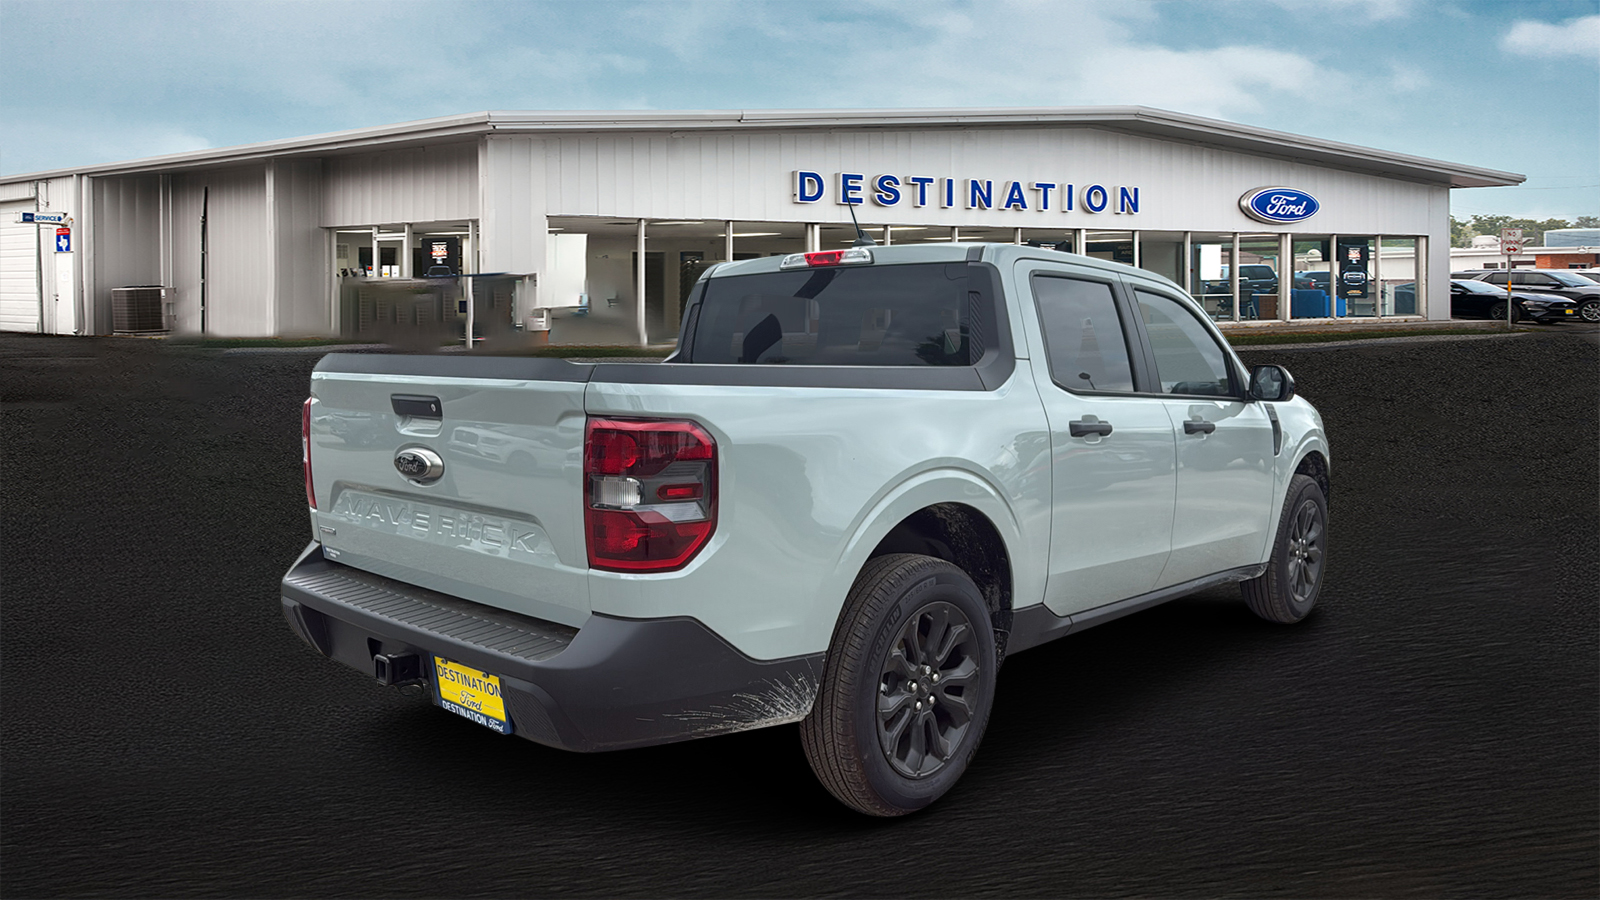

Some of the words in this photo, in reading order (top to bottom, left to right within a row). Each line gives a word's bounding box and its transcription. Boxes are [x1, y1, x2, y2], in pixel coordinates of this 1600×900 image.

[793, 170, 1141, 215] DESTINATION
[1266, 194, 1307, 216] Ford
[399, 454, 419, 473] Ford
[343, 497, 536, 554] MAVERICK
[437, 664, 503, 699] DESTINATION
[441, 700, 487, 726] DESTINATION
[488, 718, 504, 732] Ford
[459, 690, 483, 712] Ford
